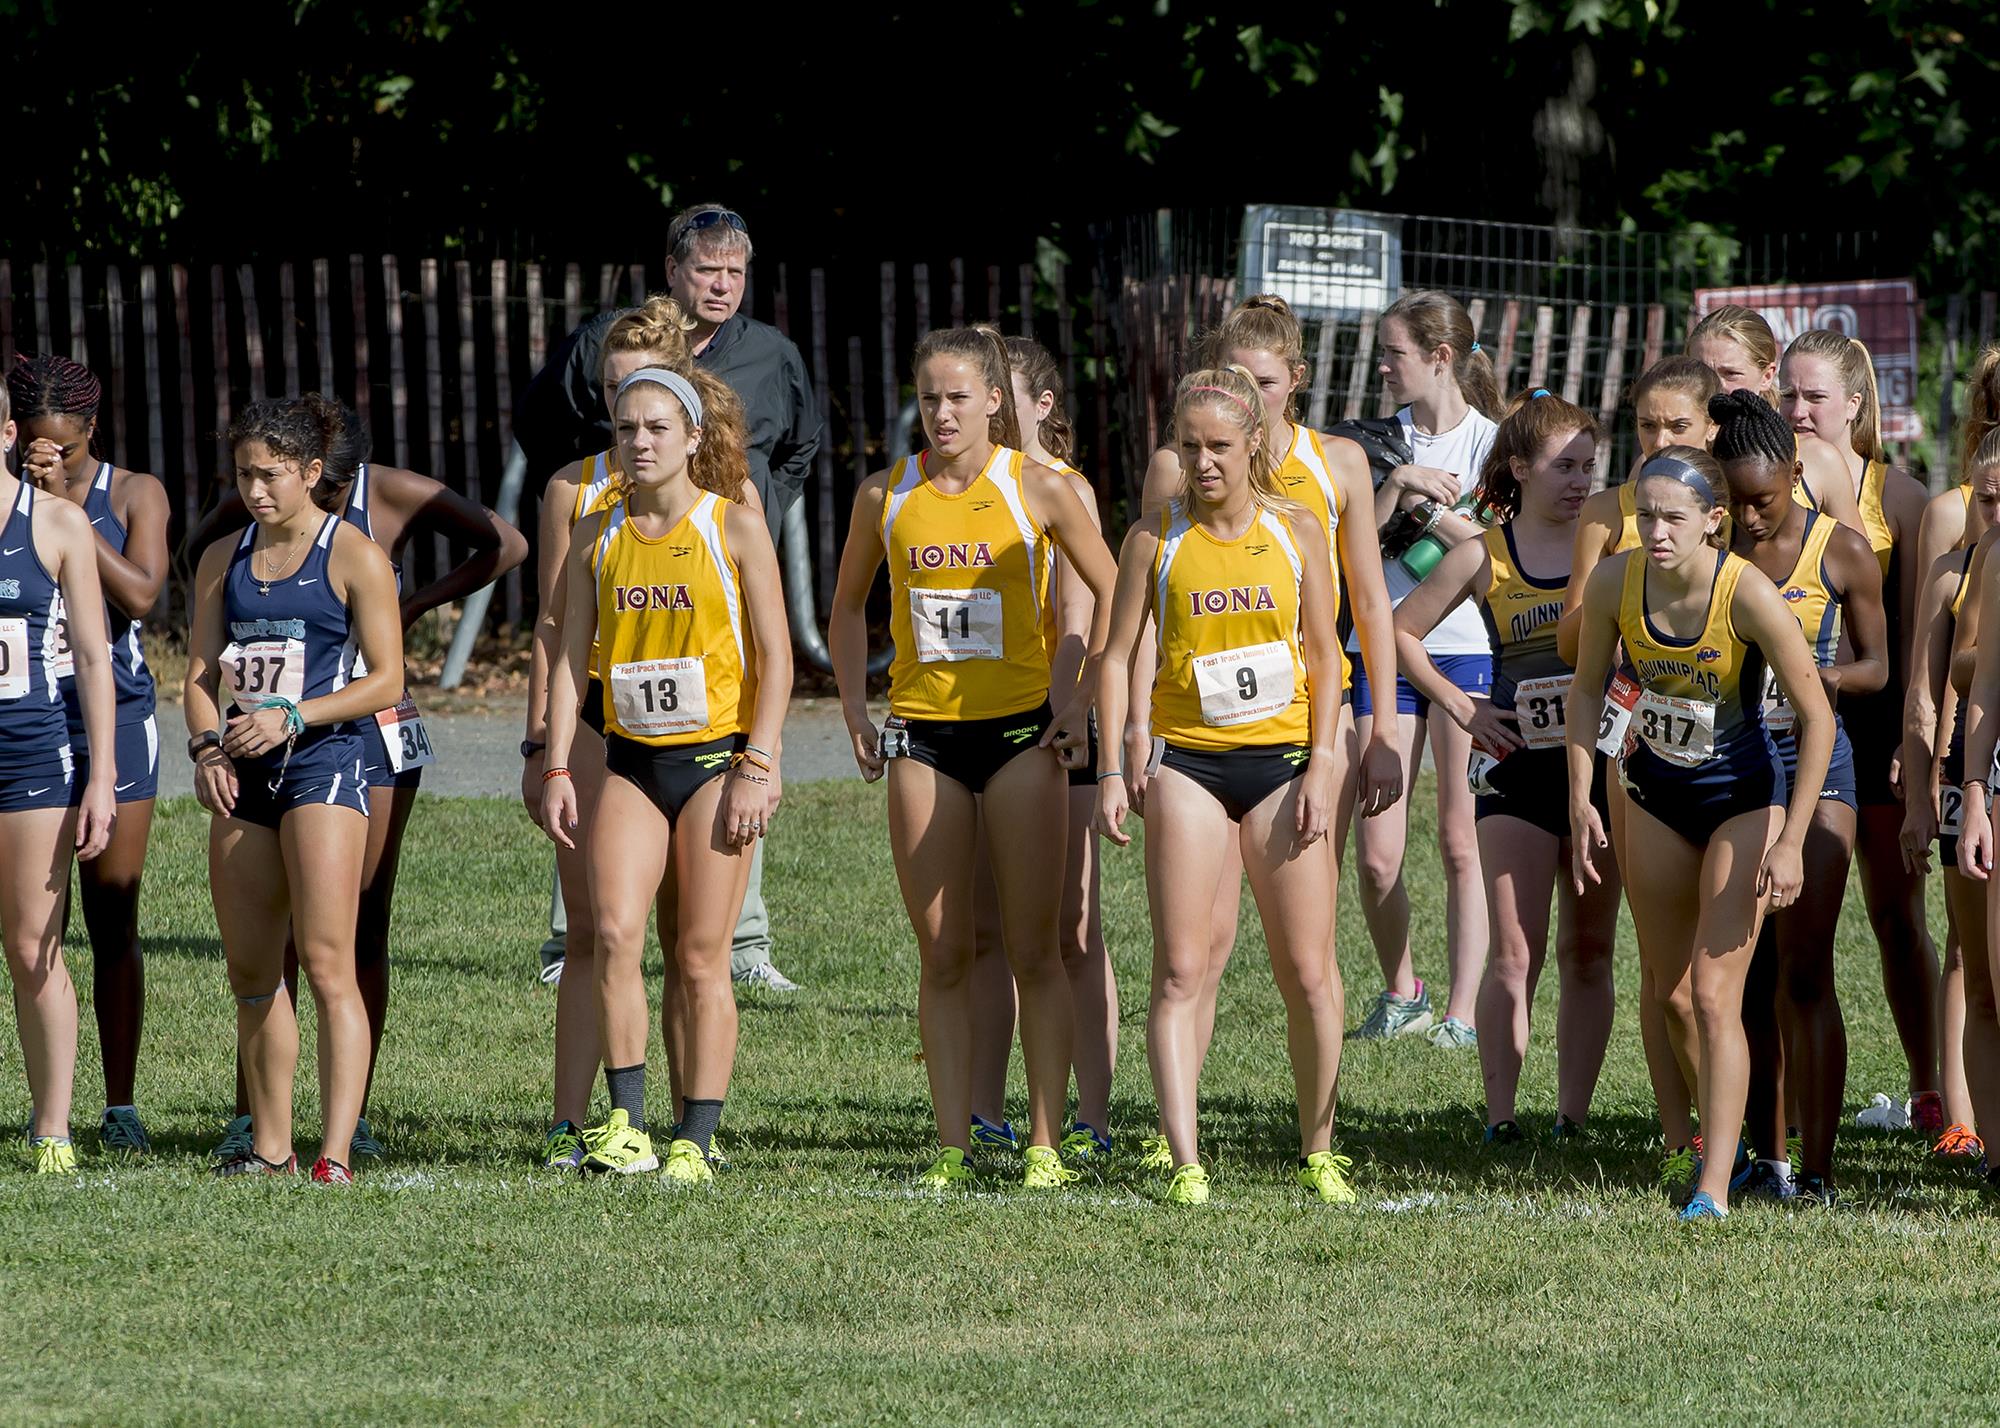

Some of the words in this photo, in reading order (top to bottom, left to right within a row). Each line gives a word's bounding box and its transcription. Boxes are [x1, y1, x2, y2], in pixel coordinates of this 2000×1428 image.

[1288, 232, 1316, 247] NO
[908, 542, 996, 571] IONA
[614, 584, 694, 611] IONA
[979, 592, 992, 600] LLC
[1189, 585, 1278, 617] IONA
[936, 607, 969, 639] 11
[234, 656, 286, 694] 337
[621, 666, 636, 675] Fast
[637, 663, 656, 673] Track
[658, 662, 680, 671] Timing
[680, 660, 694, 669] LLC
[1202, 658, 1219, 668] Fast
[1220, 653, 1241, 664] Track
[1235, 667, 1258, 701] 9
[1638, 659, 1720, 701] QUINNIPIAC
[638, 678, 679, 713] 13
[1003, 724, 1040, 738] BROOKS
[1641, 708, 1696, 747] 317
[694, 750, 732, 763] BROOKS
